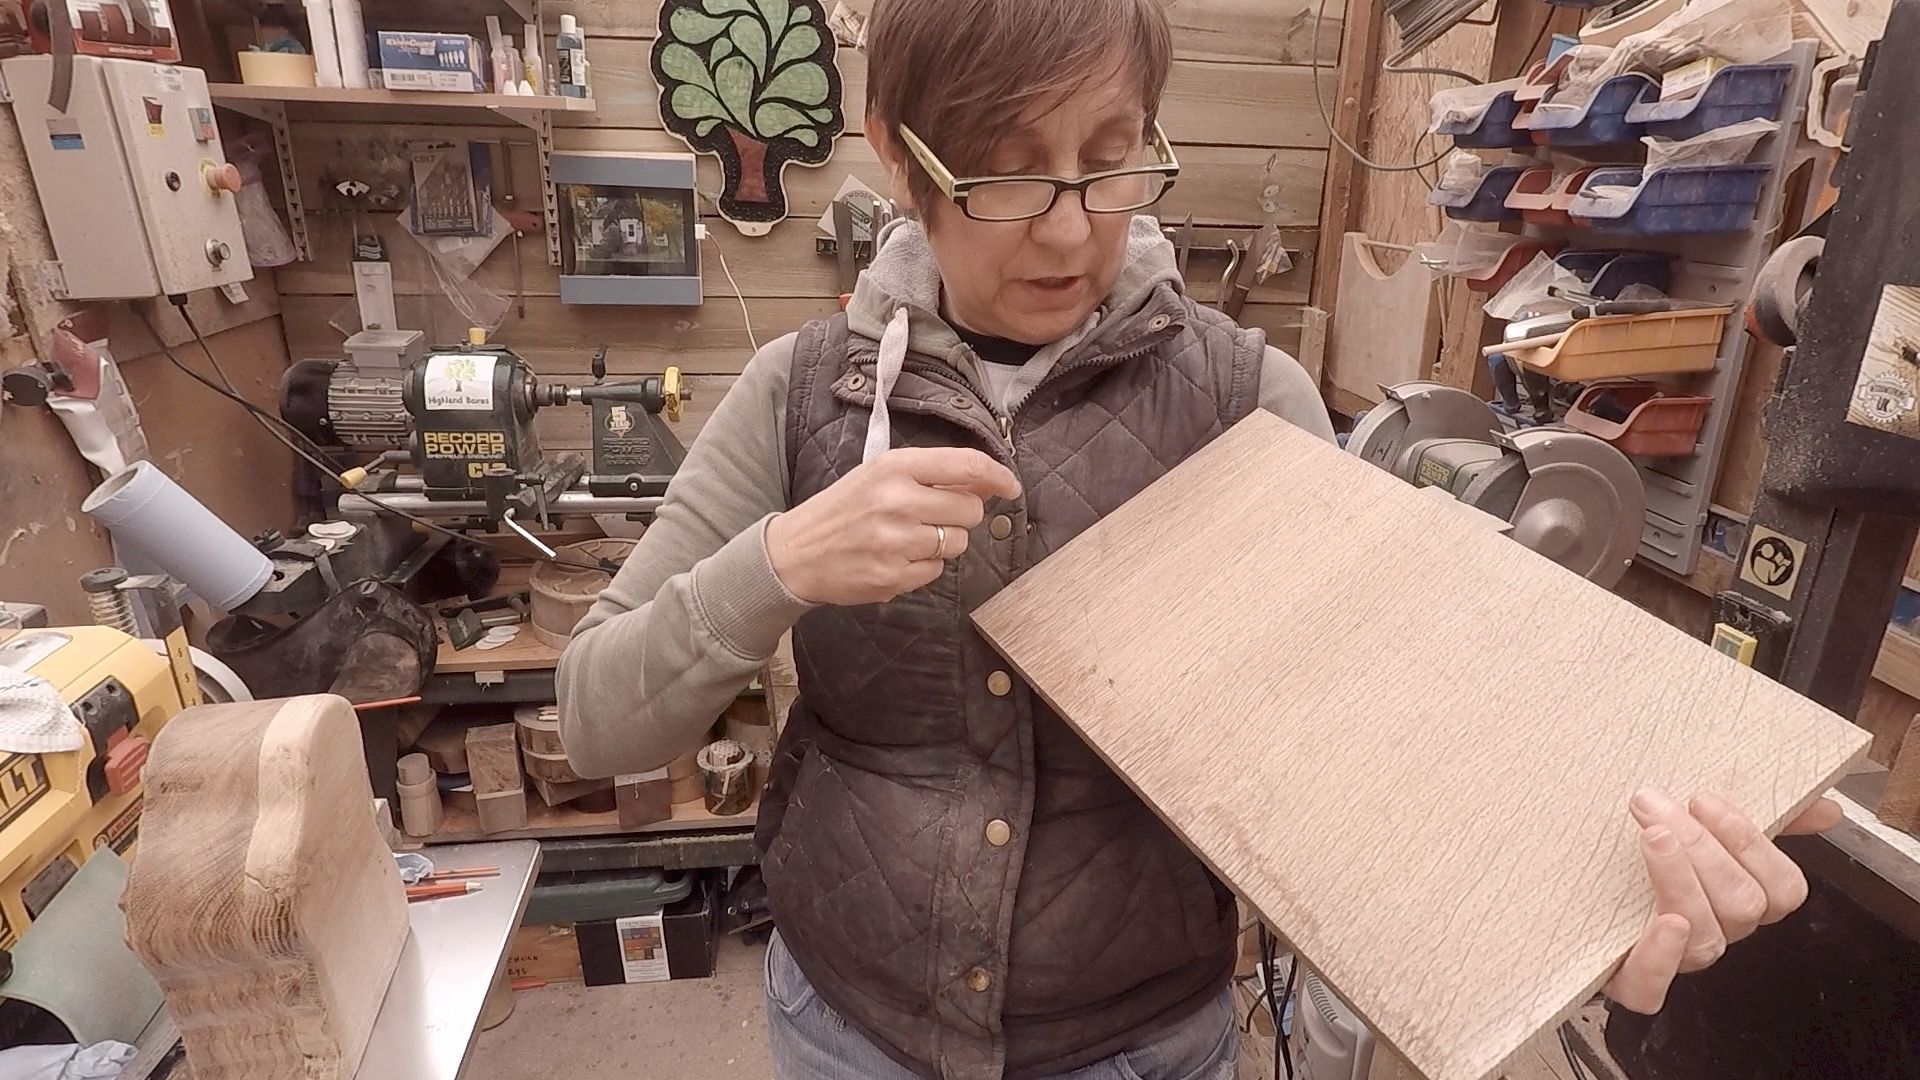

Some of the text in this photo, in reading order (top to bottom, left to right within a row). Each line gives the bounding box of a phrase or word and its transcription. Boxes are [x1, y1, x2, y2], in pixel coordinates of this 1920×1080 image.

[611, 406, 626, 421] 5
[424, 432, 504, 443] RECORD
[425, 443, 506, 454] POWER
